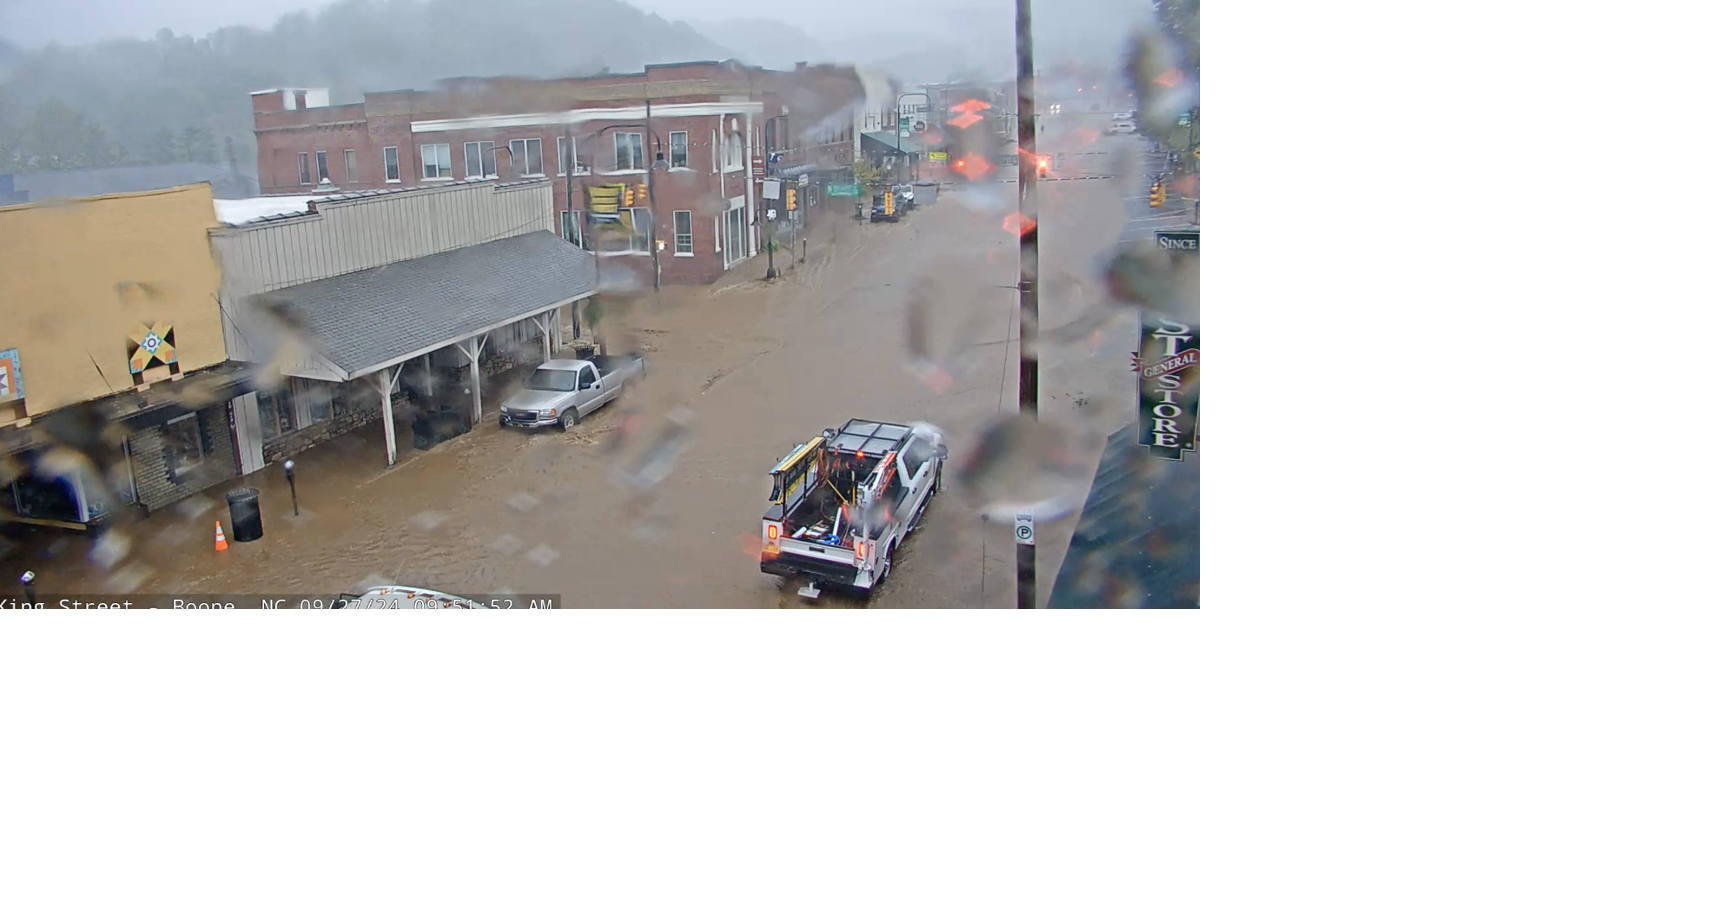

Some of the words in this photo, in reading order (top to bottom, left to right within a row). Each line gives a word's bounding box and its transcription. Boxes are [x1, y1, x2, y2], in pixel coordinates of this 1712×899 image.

[1143, 351, 1198, 378] GENERAL
[1151, 374, 1185, 448] STORE
[1021, 528, 1029, 537] P
